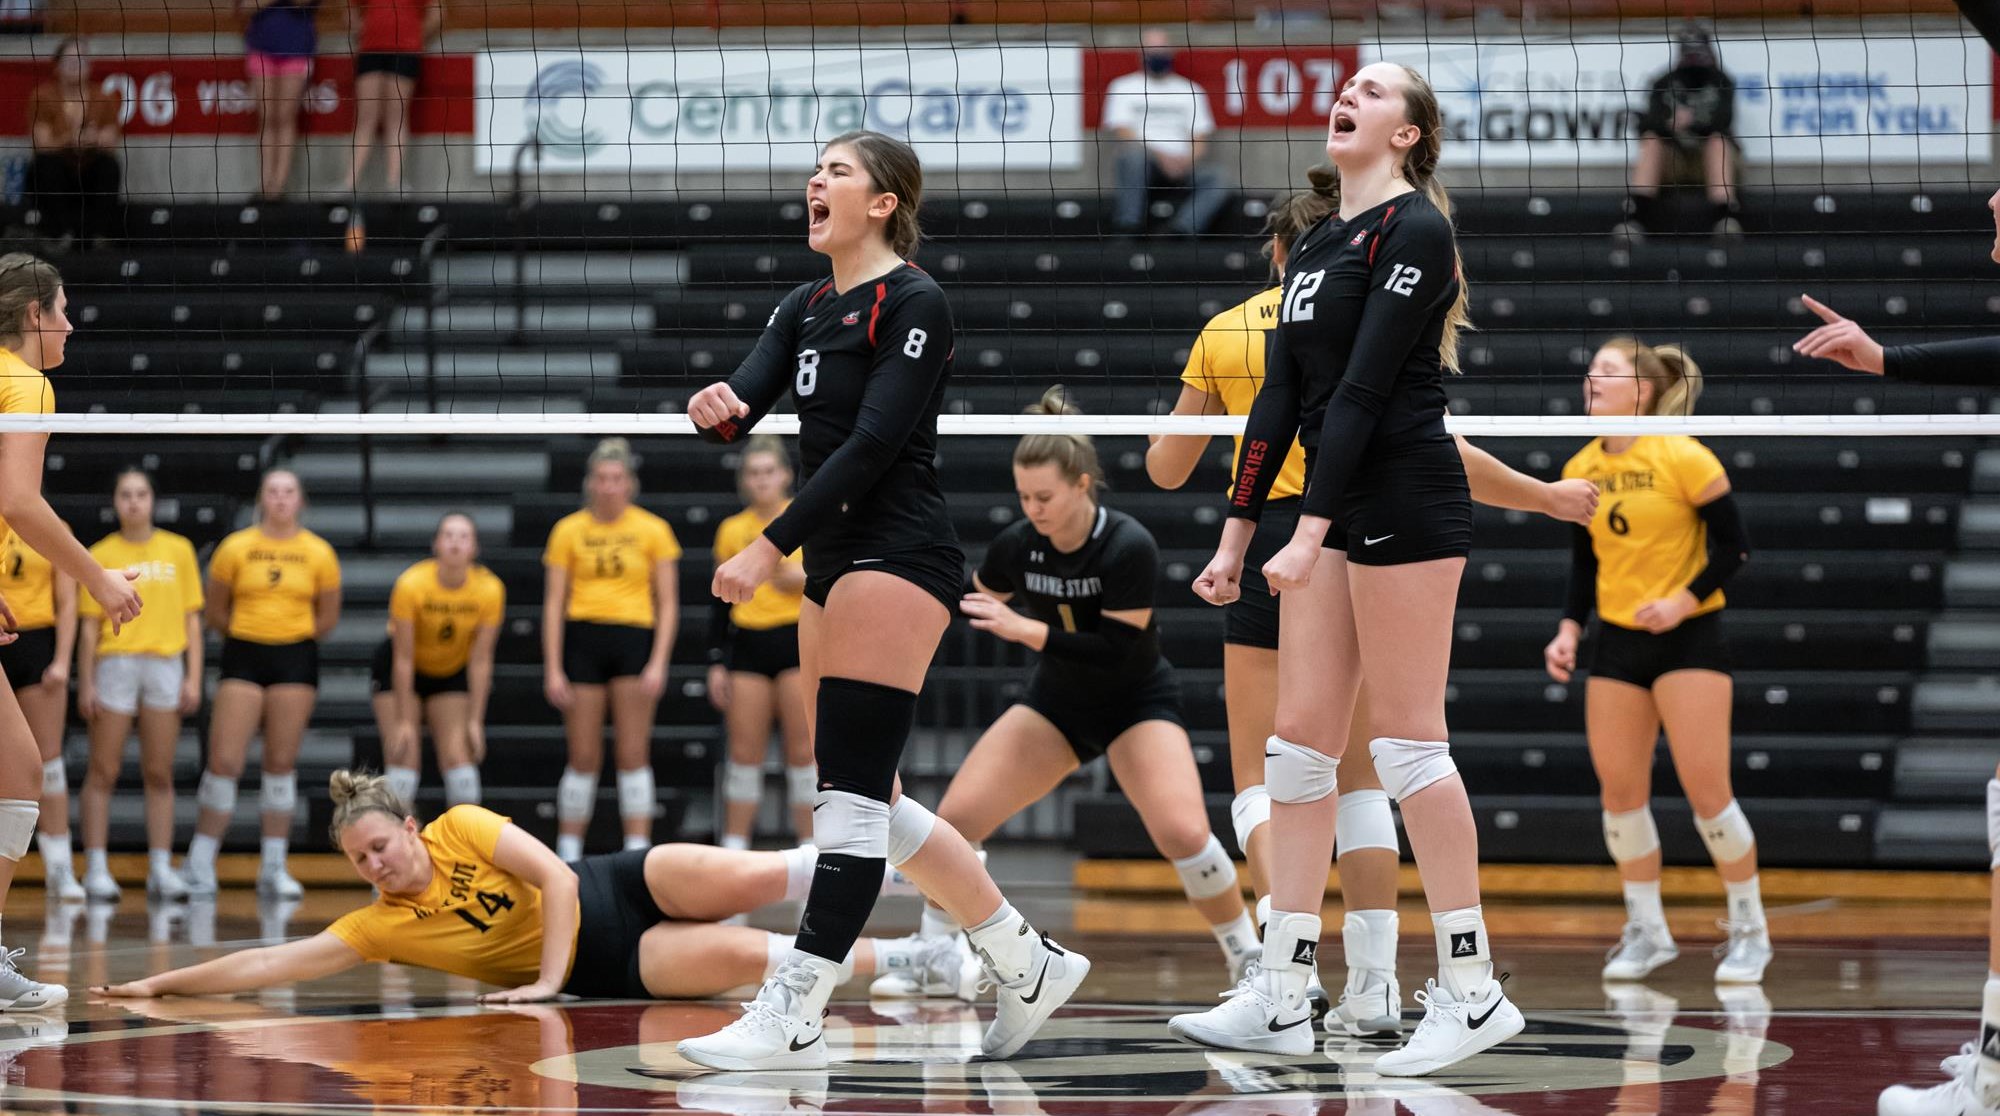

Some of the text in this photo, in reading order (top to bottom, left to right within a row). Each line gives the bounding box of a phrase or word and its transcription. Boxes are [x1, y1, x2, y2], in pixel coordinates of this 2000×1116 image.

[1223, 58, 1343, 117] 107
[1779, 72, 1888, 100] WORK
[633, 80, 1030, 135] CentraCare
[1780, 104, 1856, 132] FOR
[1283, 268, 1326, 323] 12
[1384, 263, 1422, 297] 12
[903, 327, 928, 359] 8
[796, 348, 821, 396] 8
[1234, 439, 1269, 507] HUSKIES
[1608, 500, 1631, 537] 6
[1056, 603, 1078, 634] 1
[453, 890, 516, 934] 14
